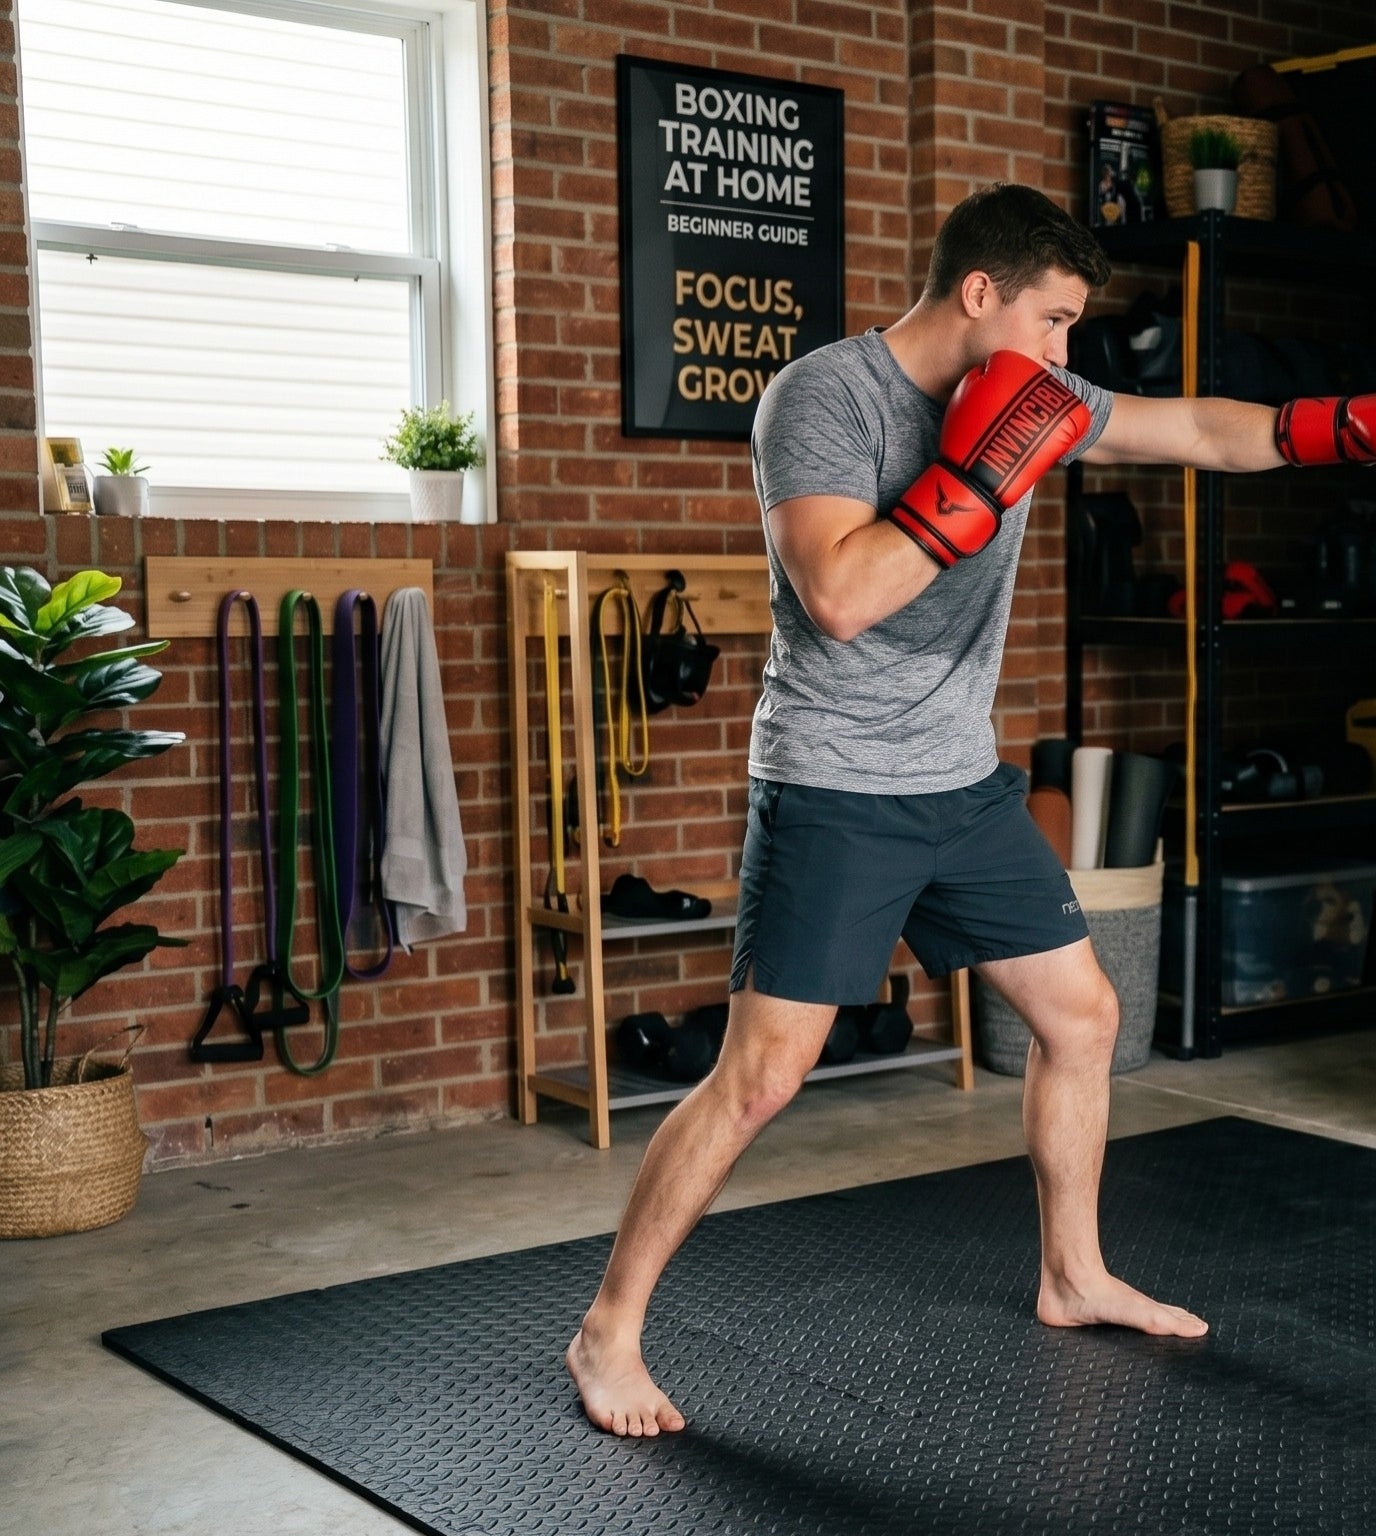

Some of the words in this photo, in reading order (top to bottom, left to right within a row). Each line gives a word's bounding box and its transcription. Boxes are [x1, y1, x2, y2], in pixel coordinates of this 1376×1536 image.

[675, 82, 800, 131] BOXING
[658, 119, 814, 171] TRAINING
[663, 160, 708, 194] AT
[717, 166, 812, 208] HOME
[667, 213, 754, 240] BEGINNER
[757, 224, 808, 247] GUIDE
[675, 270, 803, 321] FOCUS,
[672, 317, 797, 361] SWEAT
